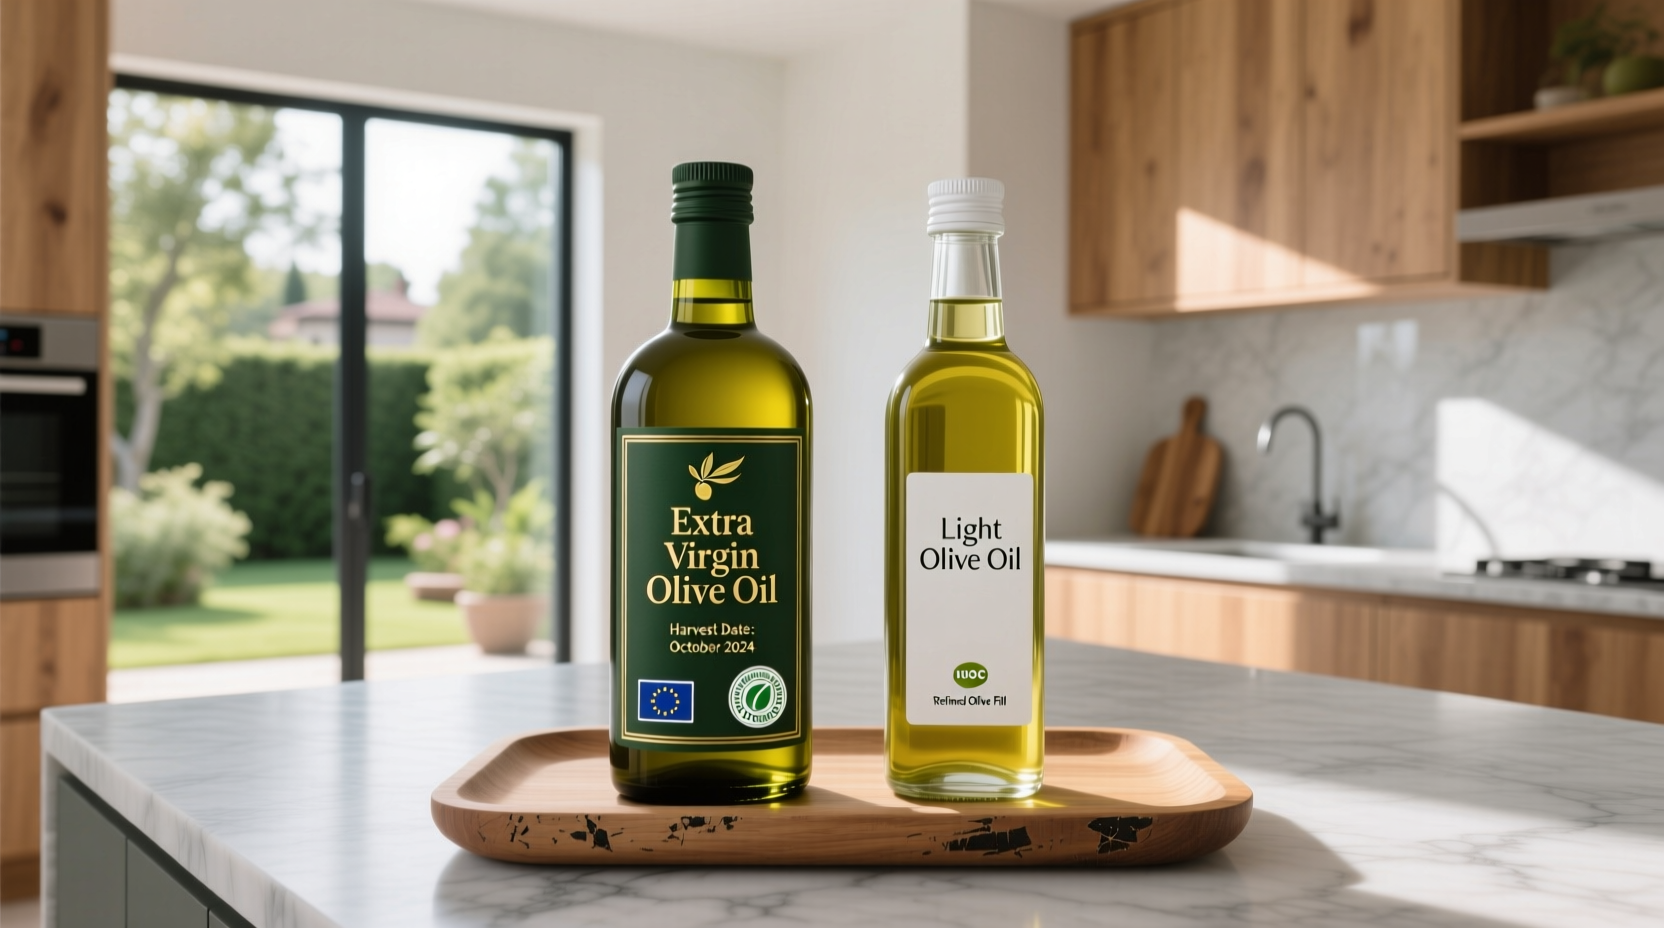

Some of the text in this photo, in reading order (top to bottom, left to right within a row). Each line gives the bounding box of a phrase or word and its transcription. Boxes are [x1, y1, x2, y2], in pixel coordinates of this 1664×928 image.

[670, 506, 754, 536] Extra
[942, 516, 1002, 547] Light
[663, 541, 760, 578] Virgin
[920, 546, 1021, 570] Olive Oil
[646, 573, 778, 604] Olive Oil
[669, 622, 755, 636] Harvest Date:
[669, 640, 755, 654] October 2024
[955, 669, 986, 680] IUOC
